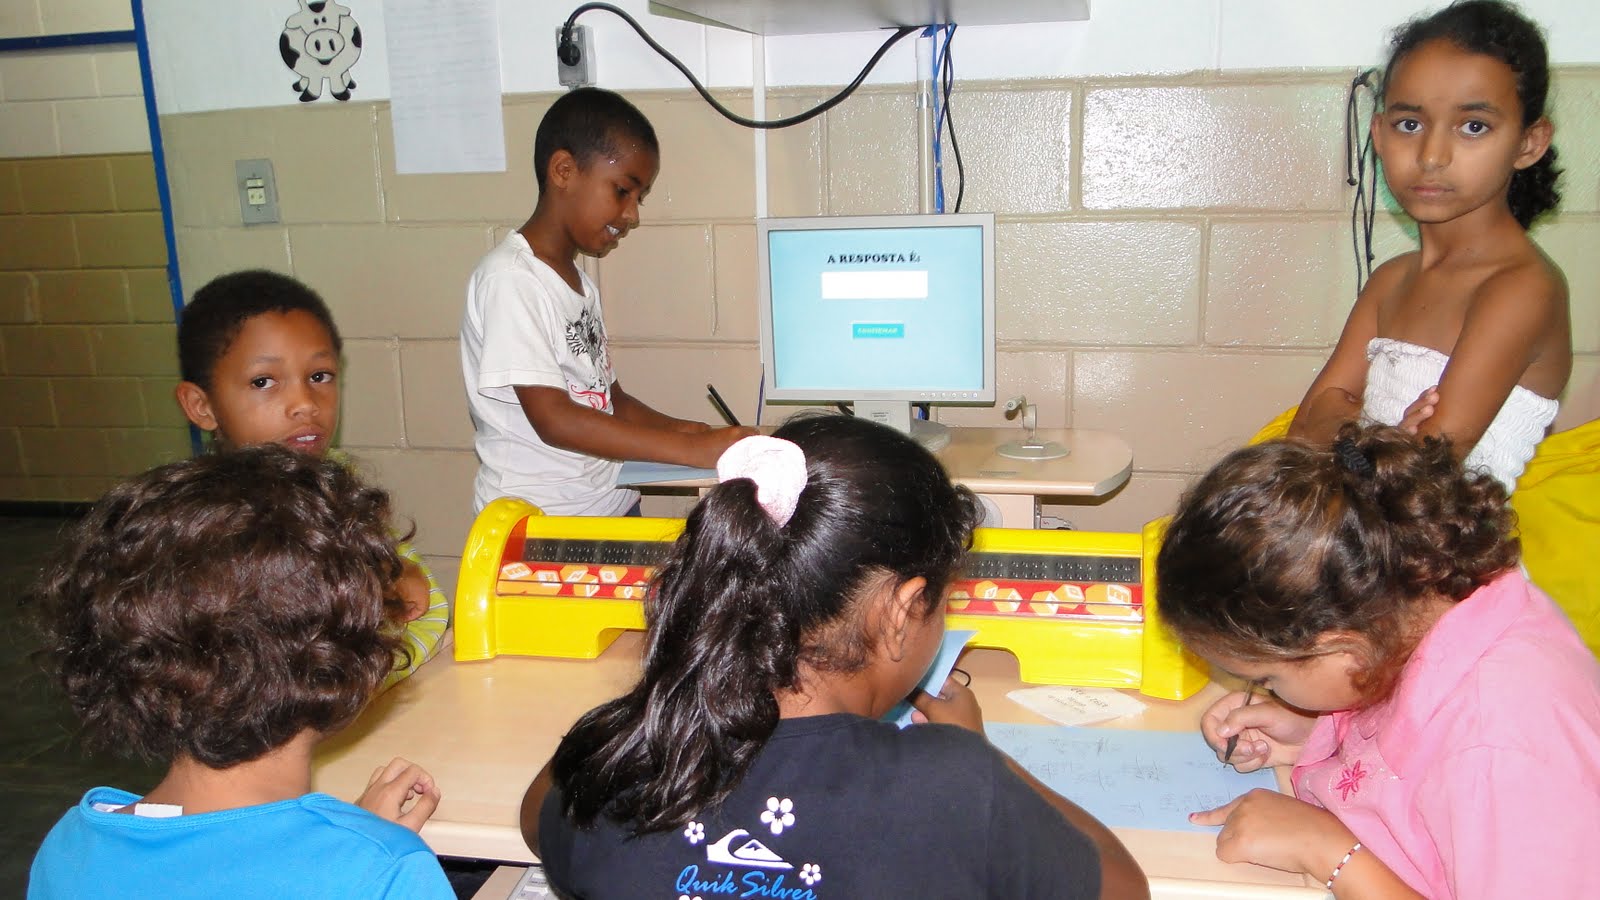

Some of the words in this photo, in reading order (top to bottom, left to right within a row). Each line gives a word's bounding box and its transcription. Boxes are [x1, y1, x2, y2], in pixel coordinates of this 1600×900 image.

[827, 254, 836, 264] A
[839, 253, 905, 264] RESPOSTA
[676, 864, 738, 894] Quik
[741, 870, 817, 900] Silver
